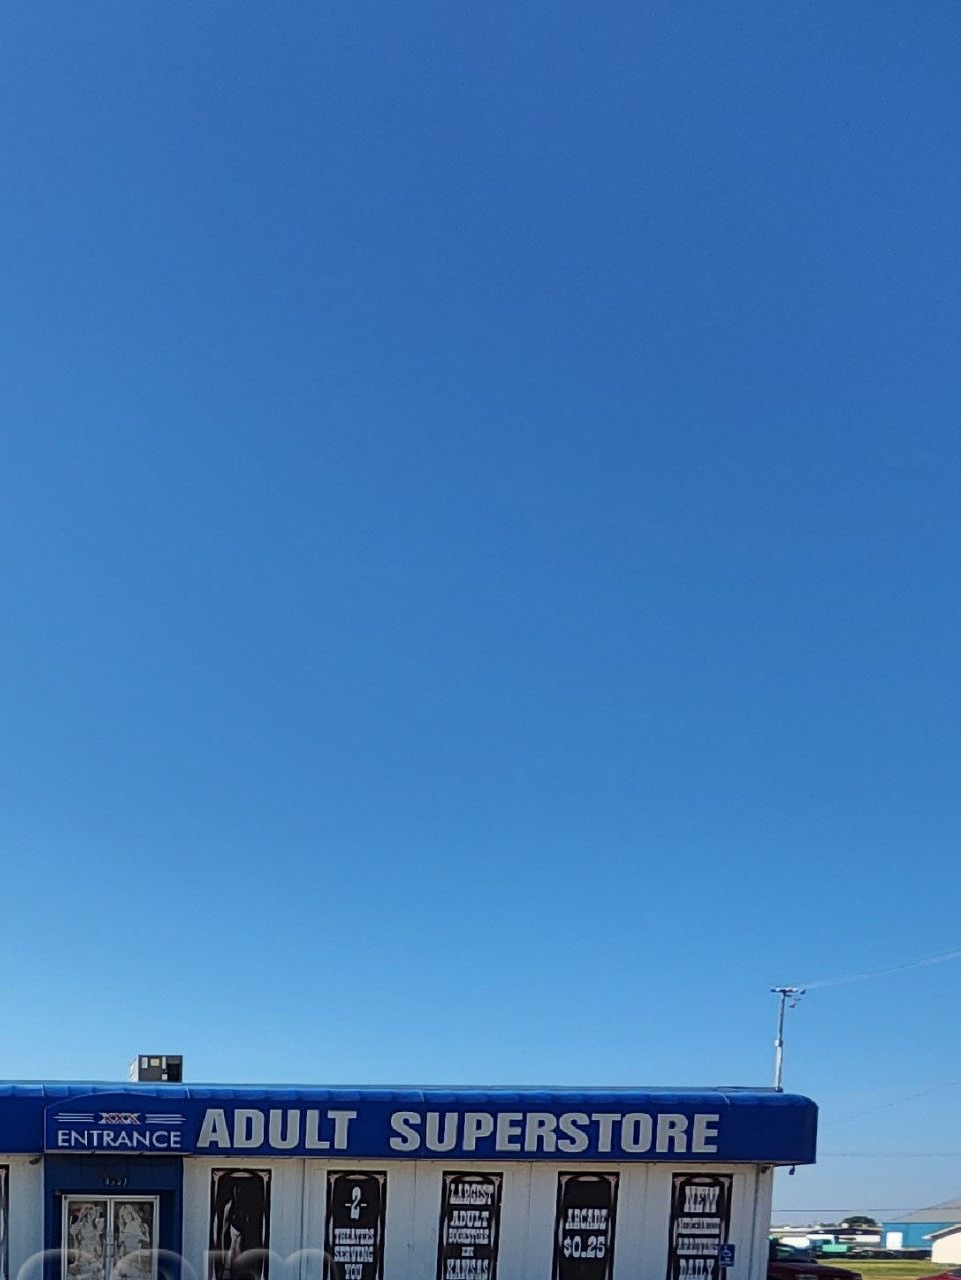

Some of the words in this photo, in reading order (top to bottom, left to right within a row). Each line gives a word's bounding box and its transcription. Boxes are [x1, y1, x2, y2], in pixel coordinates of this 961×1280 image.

[98, 1112, 142, 1125] XXX
[57, 1129, 182, 1148] ENTRANCE
[196, 1108, 357, 1150] ADULT
[389, 1111, 720, 1153] SUPERSTORE
[449, 1183, 494, 1205] LARGEST
[683, 1185, 720, 1213] NEW
[450, 1210, 490, 1228] ADULT
[565, 1208, 609, 1230] ARCADE
[563, 1236, 606, 1258] $0.25
[344, 1263, 363, 1280] YOU
[446, 1258, 489, 1280] KANSAS
